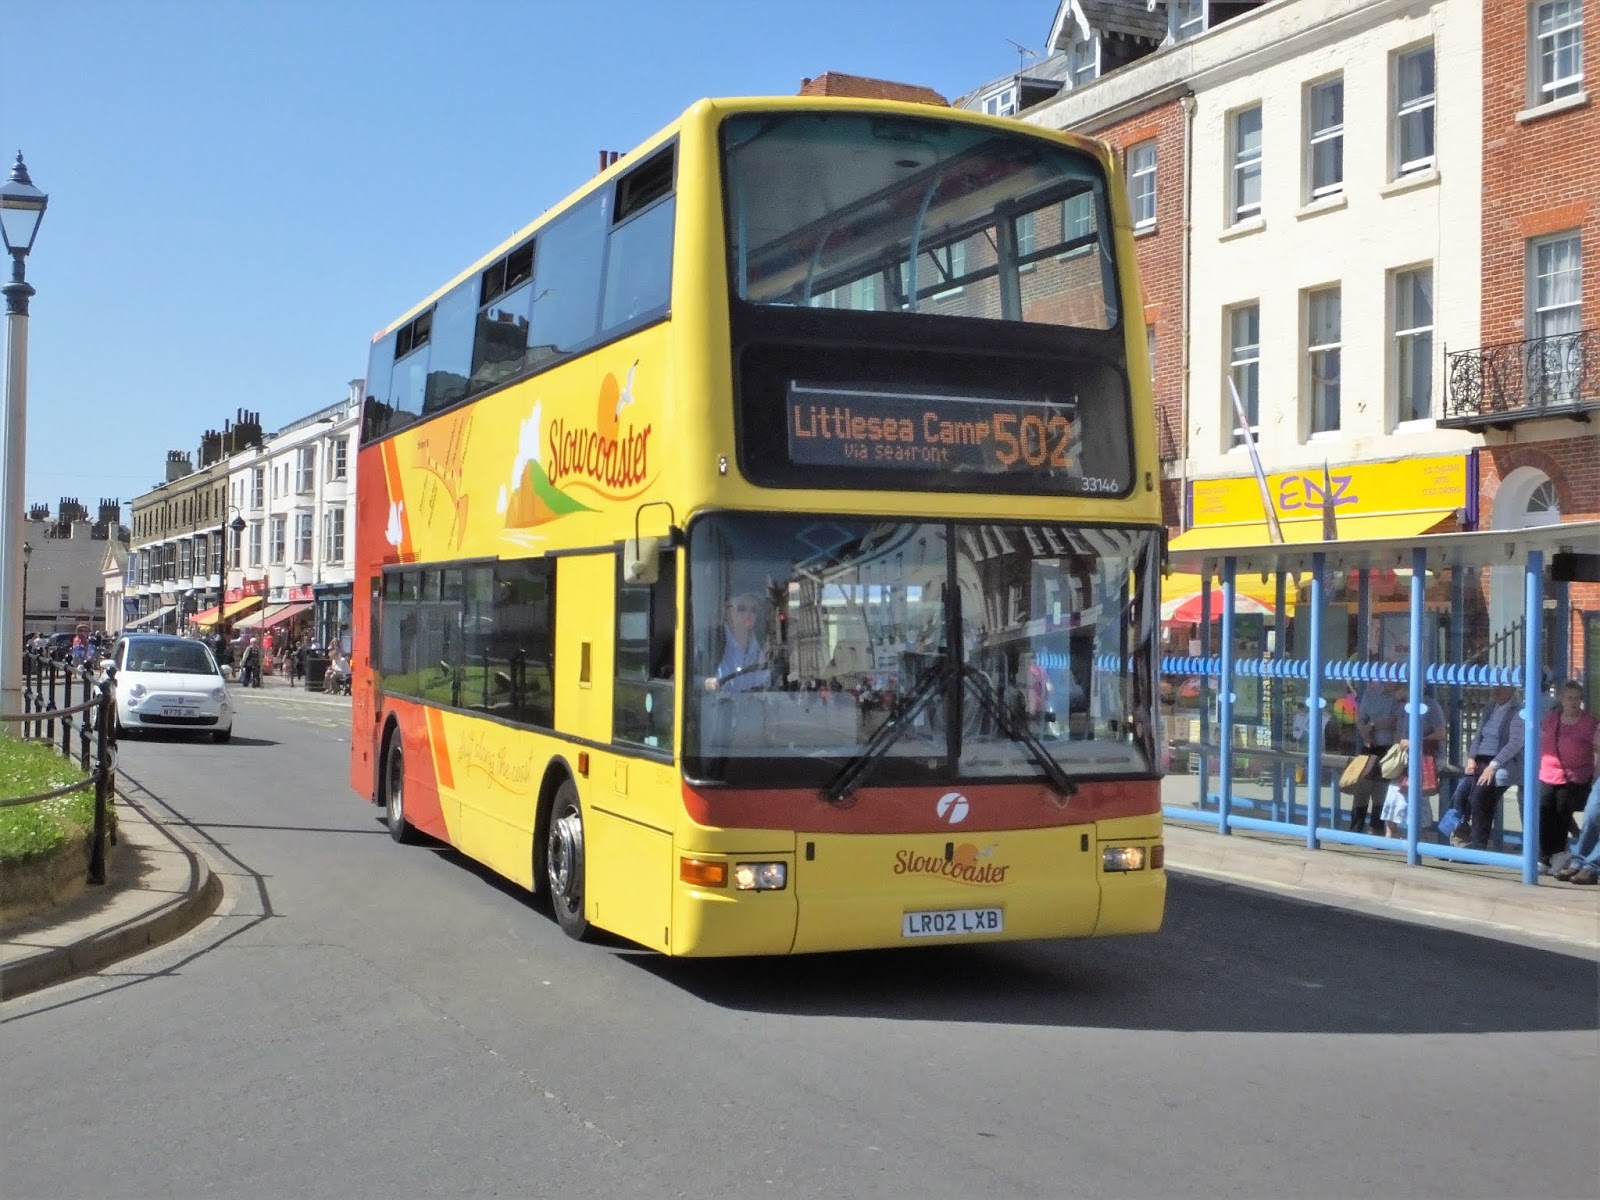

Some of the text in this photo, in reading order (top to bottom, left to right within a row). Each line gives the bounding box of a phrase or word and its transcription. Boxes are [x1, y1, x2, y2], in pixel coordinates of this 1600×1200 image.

[794, 405, 990, 444] Littlesea Camp
[993, 412, 1074, 467] 502
[548, 418, 652, 489] Slowcoaster
[1081, 477, 1119, 493] 33146
[1279, 474, 1359, 511] ENZ
[893, 849, 1010, 883] Slowcoaster
[908, 910, 999, 934] LR02 LXB
